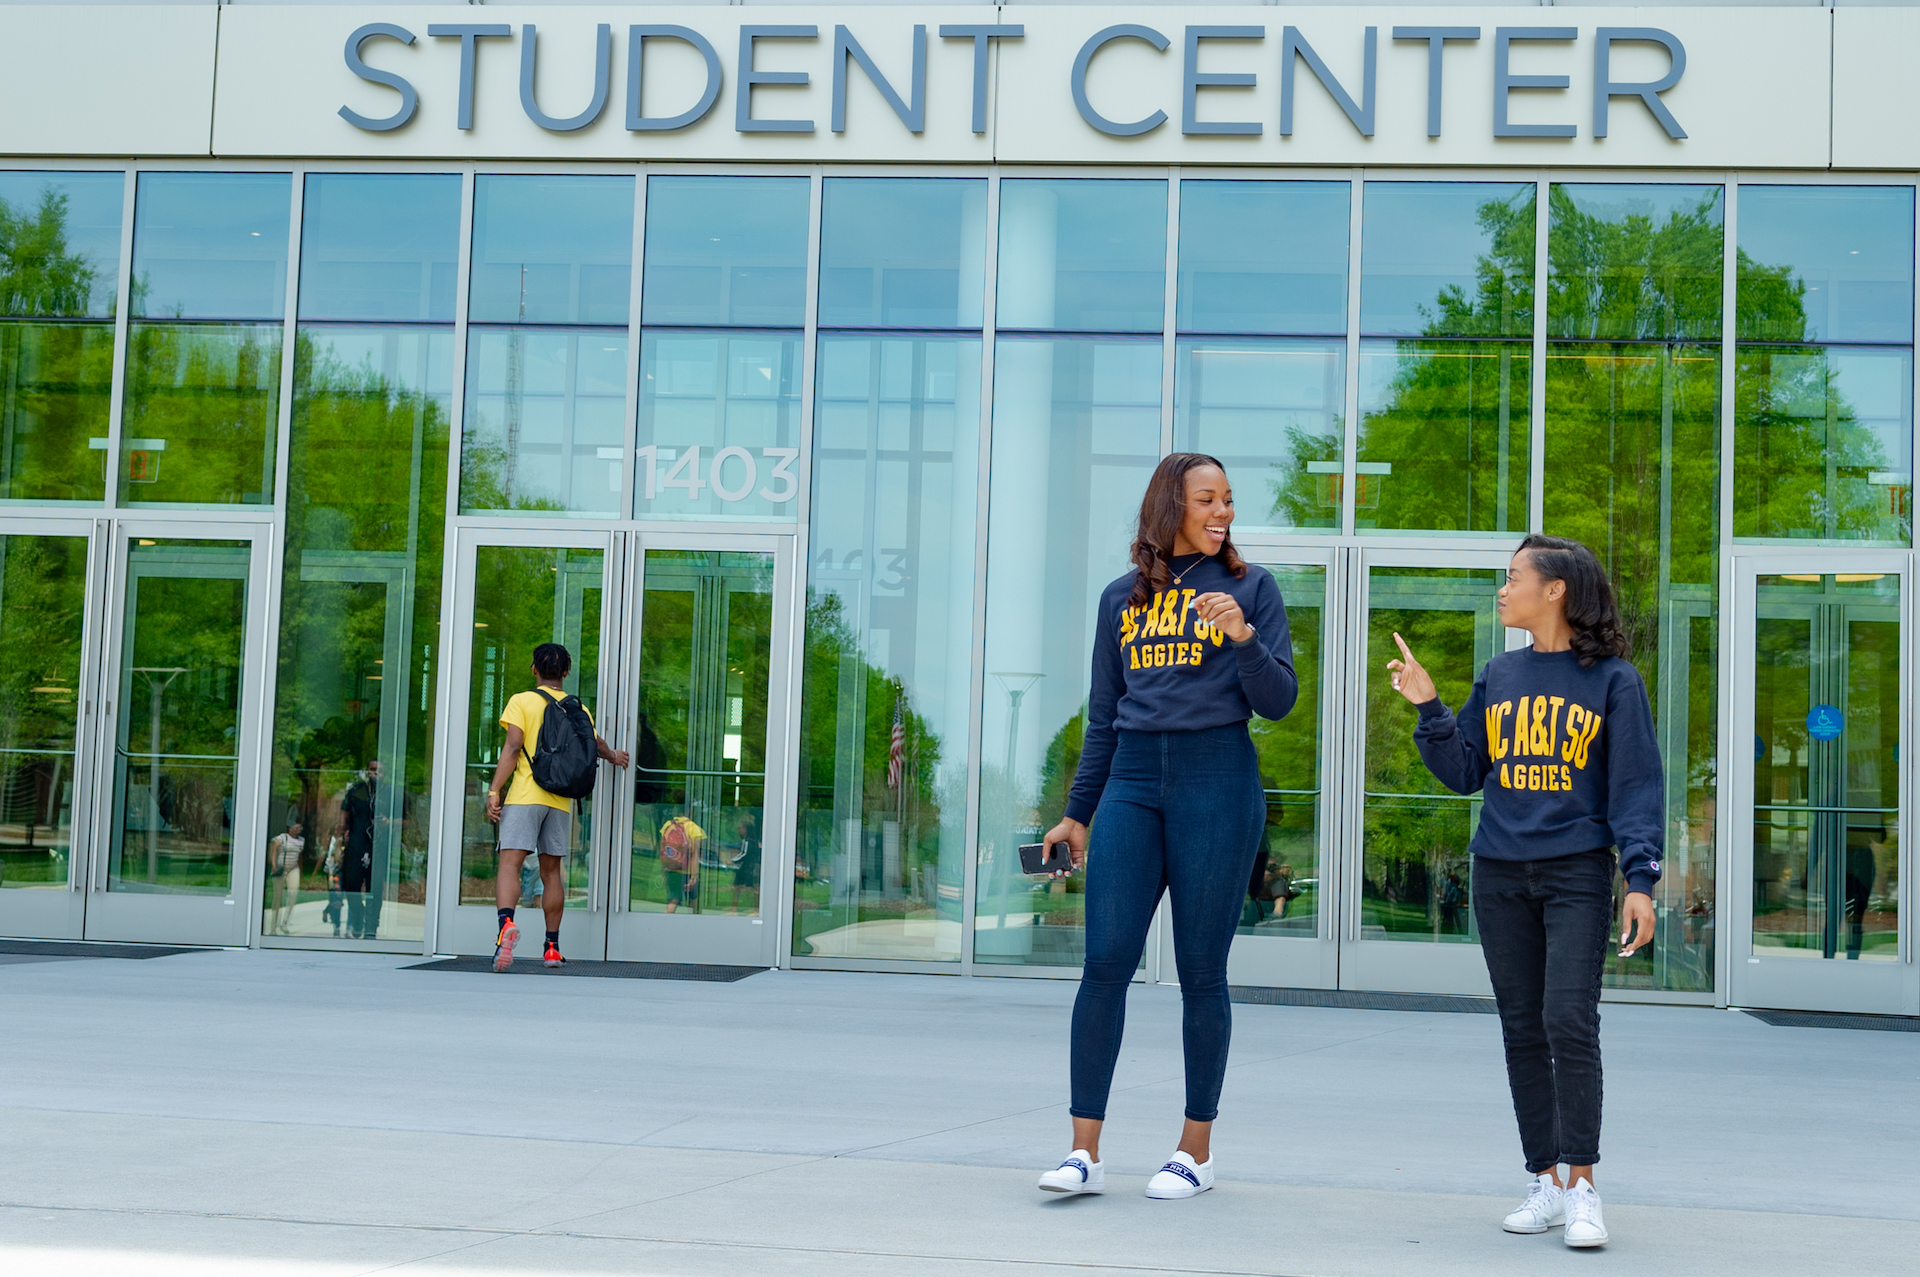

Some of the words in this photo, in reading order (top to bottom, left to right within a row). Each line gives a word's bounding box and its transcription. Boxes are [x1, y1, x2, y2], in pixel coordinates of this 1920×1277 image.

[338, 22, 1024, 133] STUDENT
[1071, 24, 1688, 138] CENTER
[636, 444, 800, 503] 1403
[1141, 588, 1196, 638] A&T
[1130, 642, 1203, 670] AGGIES
[1485, 700, 1513, 764] NC
[1513, 695, 1565, 757] A&T
[1560, 703, 1602, 770] SU
[1500, 763, 1573, 791] AGGIES
